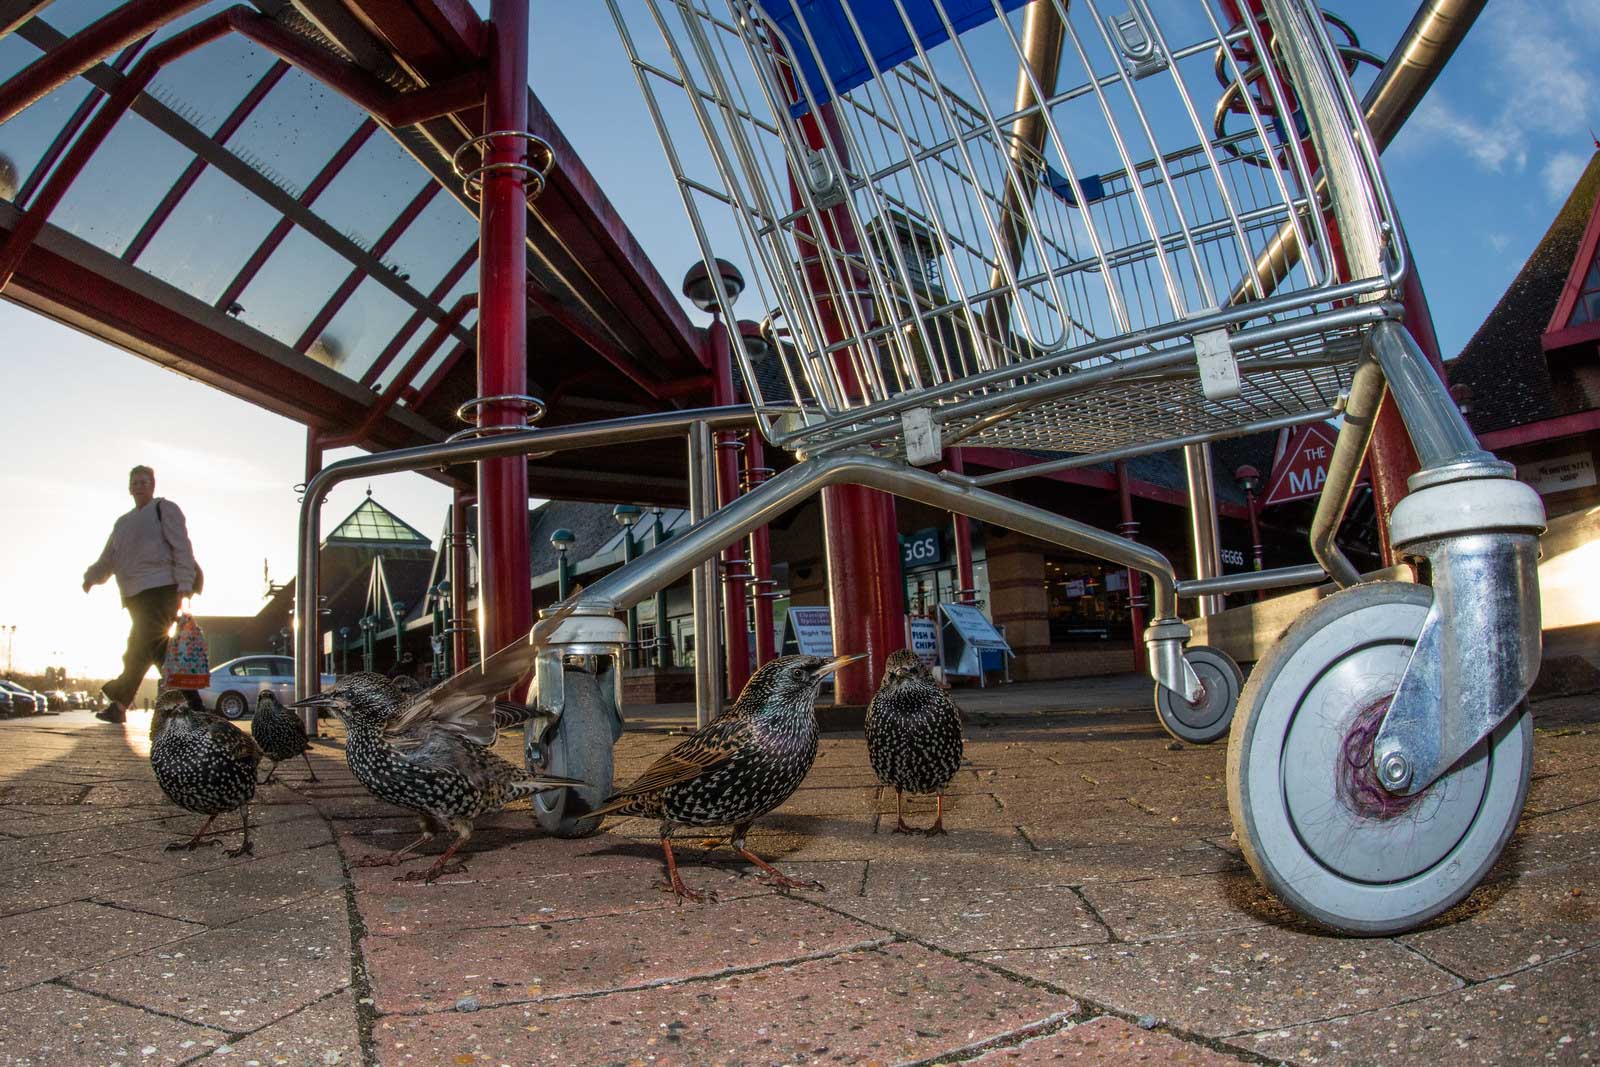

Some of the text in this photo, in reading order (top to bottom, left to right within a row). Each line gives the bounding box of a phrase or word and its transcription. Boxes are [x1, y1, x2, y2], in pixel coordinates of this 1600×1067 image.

[1304, 446, 1326, 461] THE
[912, 631, 928, 640] FISH
[915, 641, 936, 650] CHIPS
